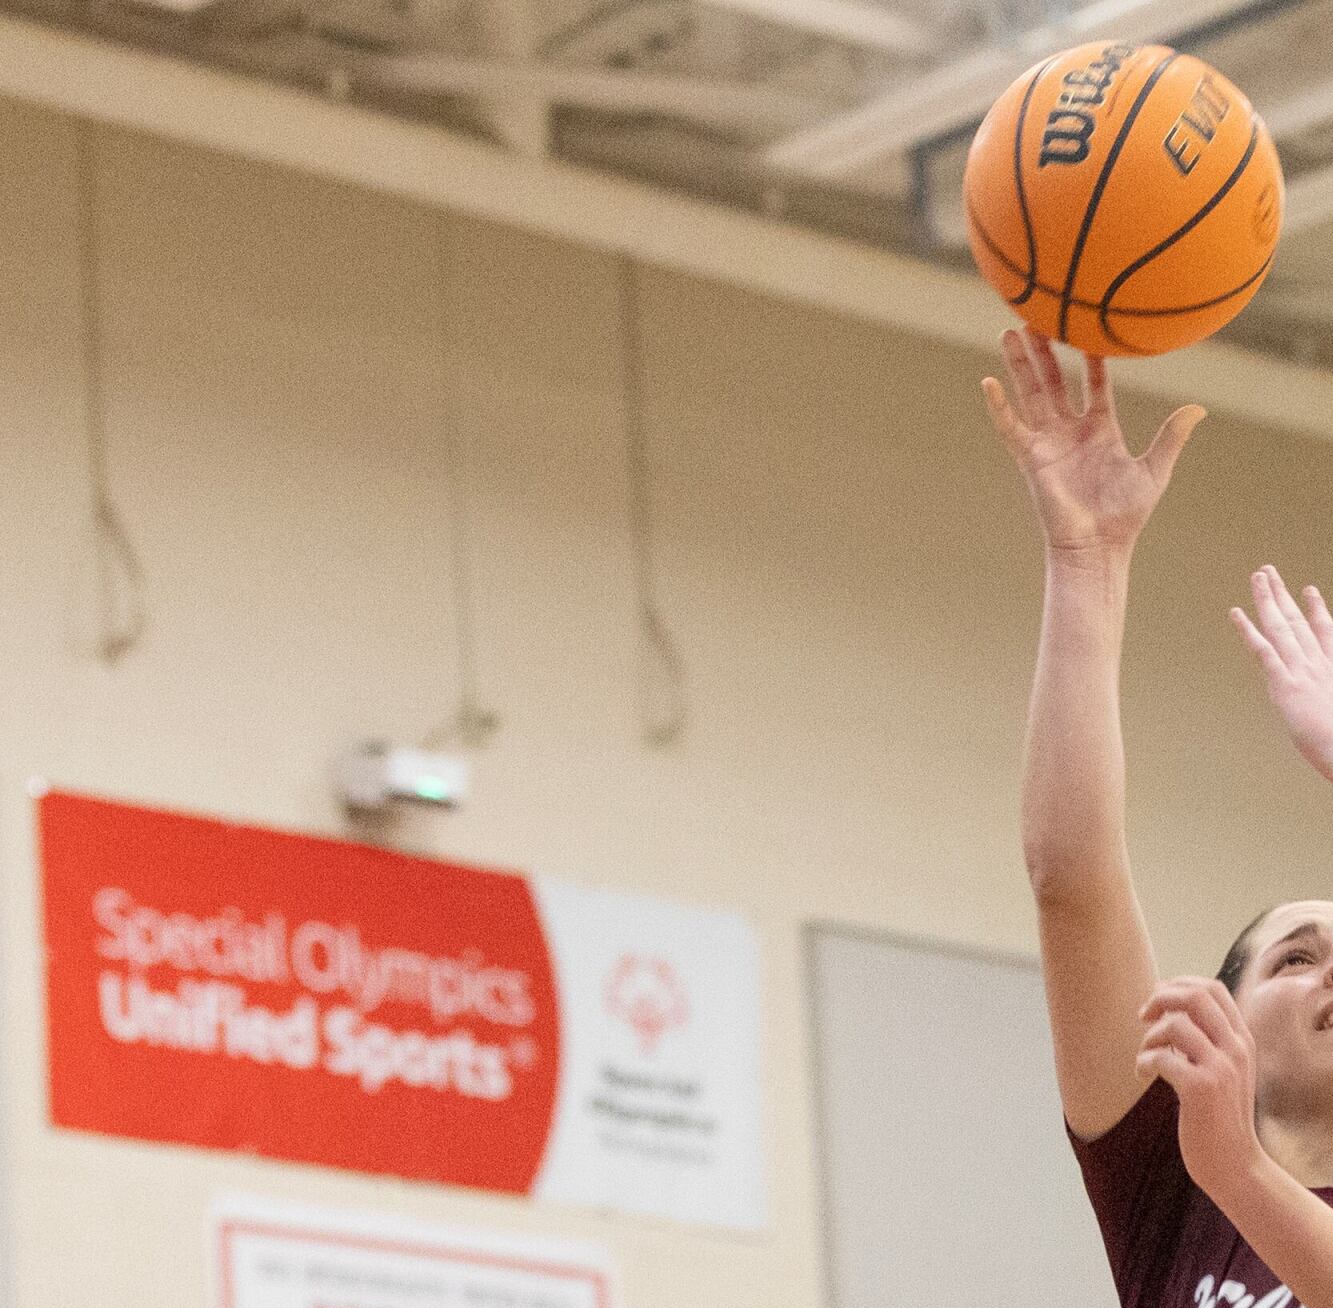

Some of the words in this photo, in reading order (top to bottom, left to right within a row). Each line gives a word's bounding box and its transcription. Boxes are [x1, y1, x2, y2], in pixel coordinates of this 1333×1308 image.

[92, 886, 292, 986] Special
[293, 918, 537, 1028] Olympics
[99, 968, 319, 1070] Unified
